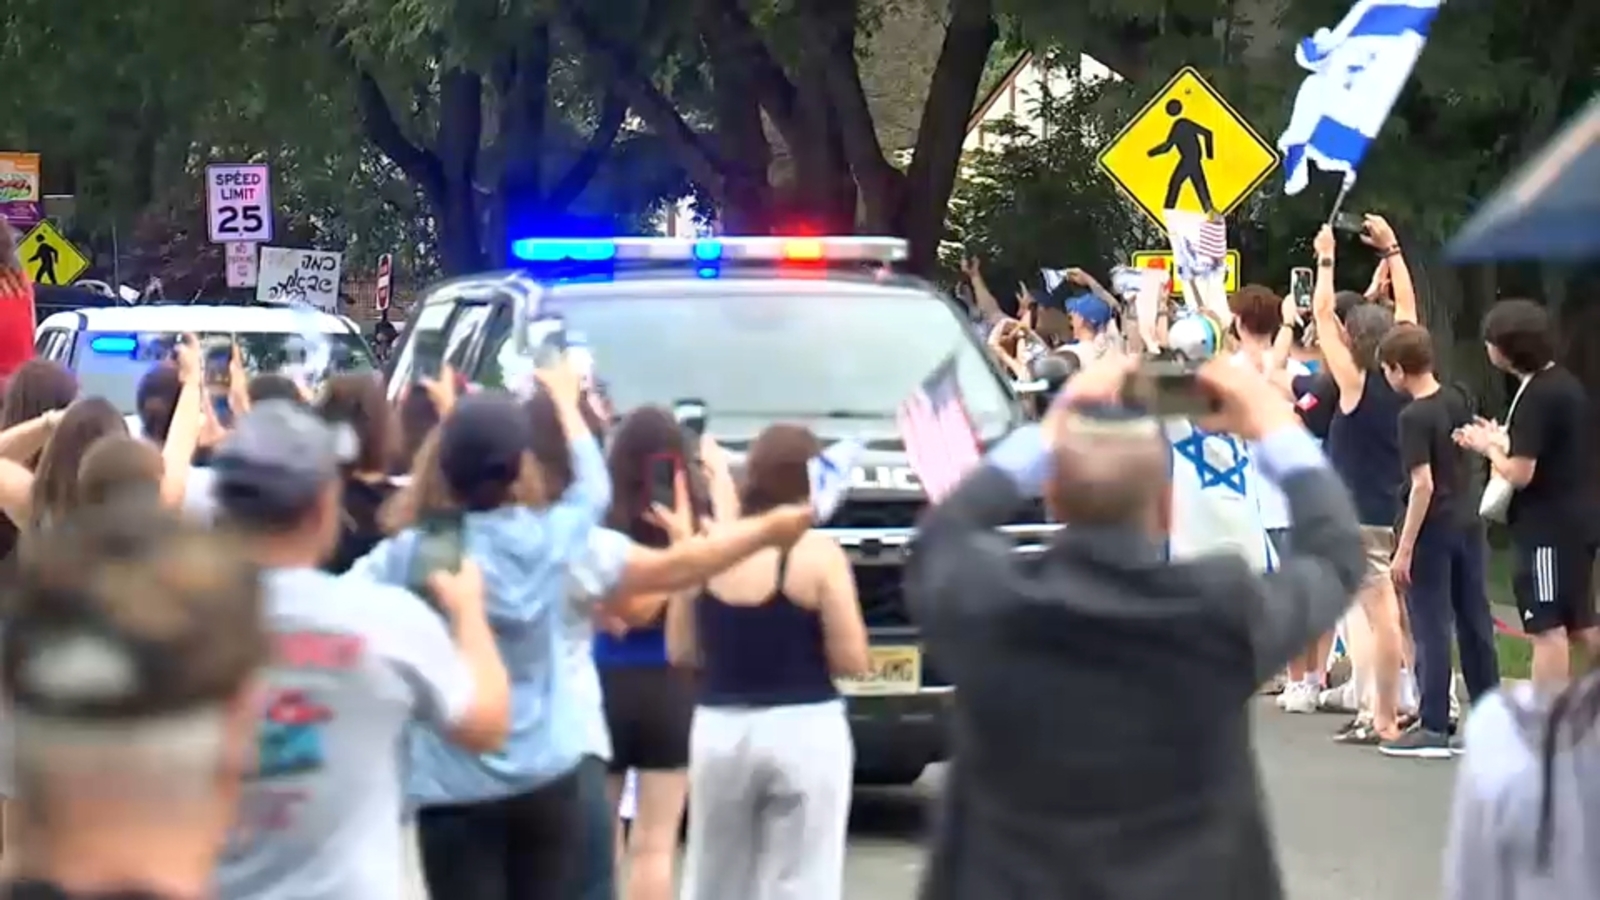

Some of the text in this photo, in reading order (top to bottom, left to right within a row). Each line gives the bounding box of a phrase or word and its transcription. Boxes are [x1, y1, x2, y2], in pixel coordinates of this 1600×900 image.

[215, 173, 261, 186] SPEED
[221, 188, 255, 201] LIMIT
[218, 205, 263, 233] 25
